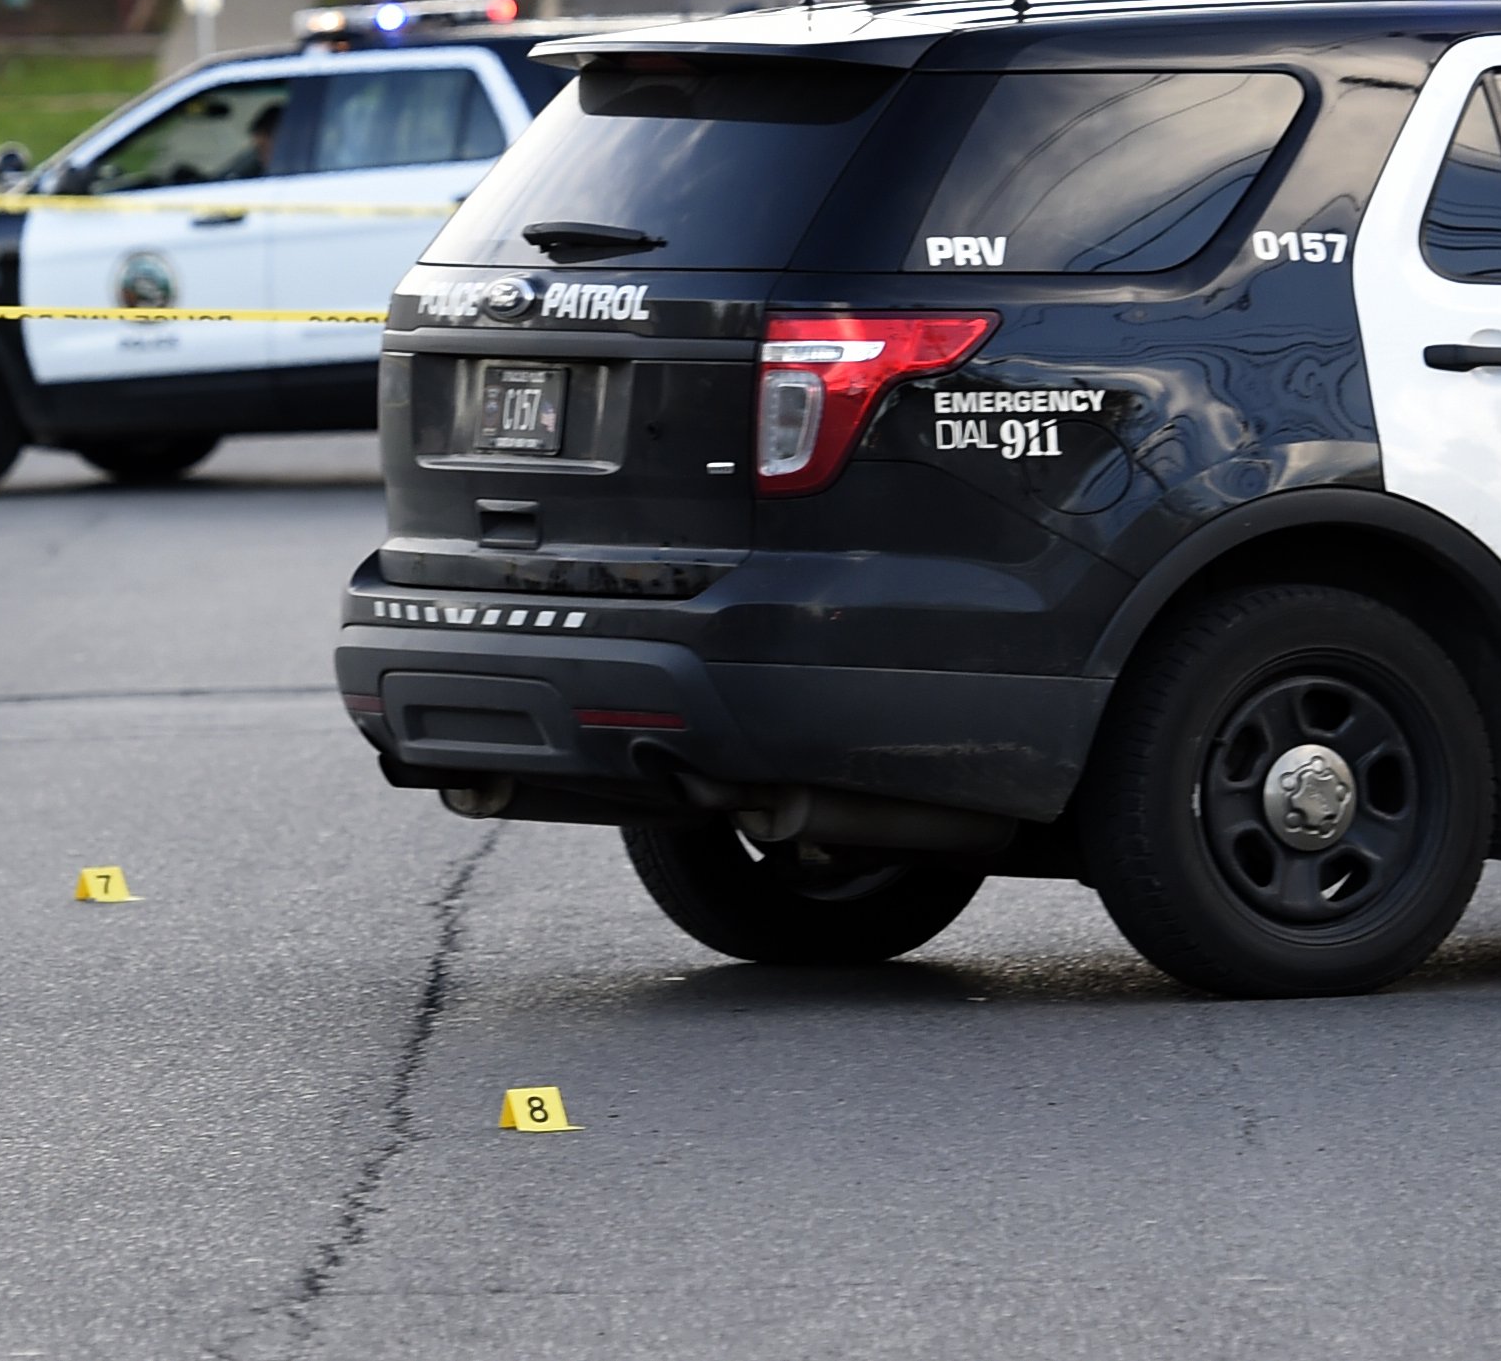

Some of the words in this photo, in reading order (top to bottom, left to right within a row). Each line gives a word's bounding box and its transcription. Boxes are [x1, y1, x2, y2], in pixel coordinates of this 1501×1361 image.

[926, 236, 1006, 266] PRV
[1252, 231, 1347, 263] 0157
[417, 282, 484, 317] POLICE
[541, 282, 649, 320] PATROL
[502, 388, 542, 431] C157
[934, 390, 1105, 413] EMERGENCY
[935, 419, 998, 450] DIAL
[999, 418, 1064, 460] 911
[95, 874, 111, 895] 7
[527, 1096, 549, 1123] 8
